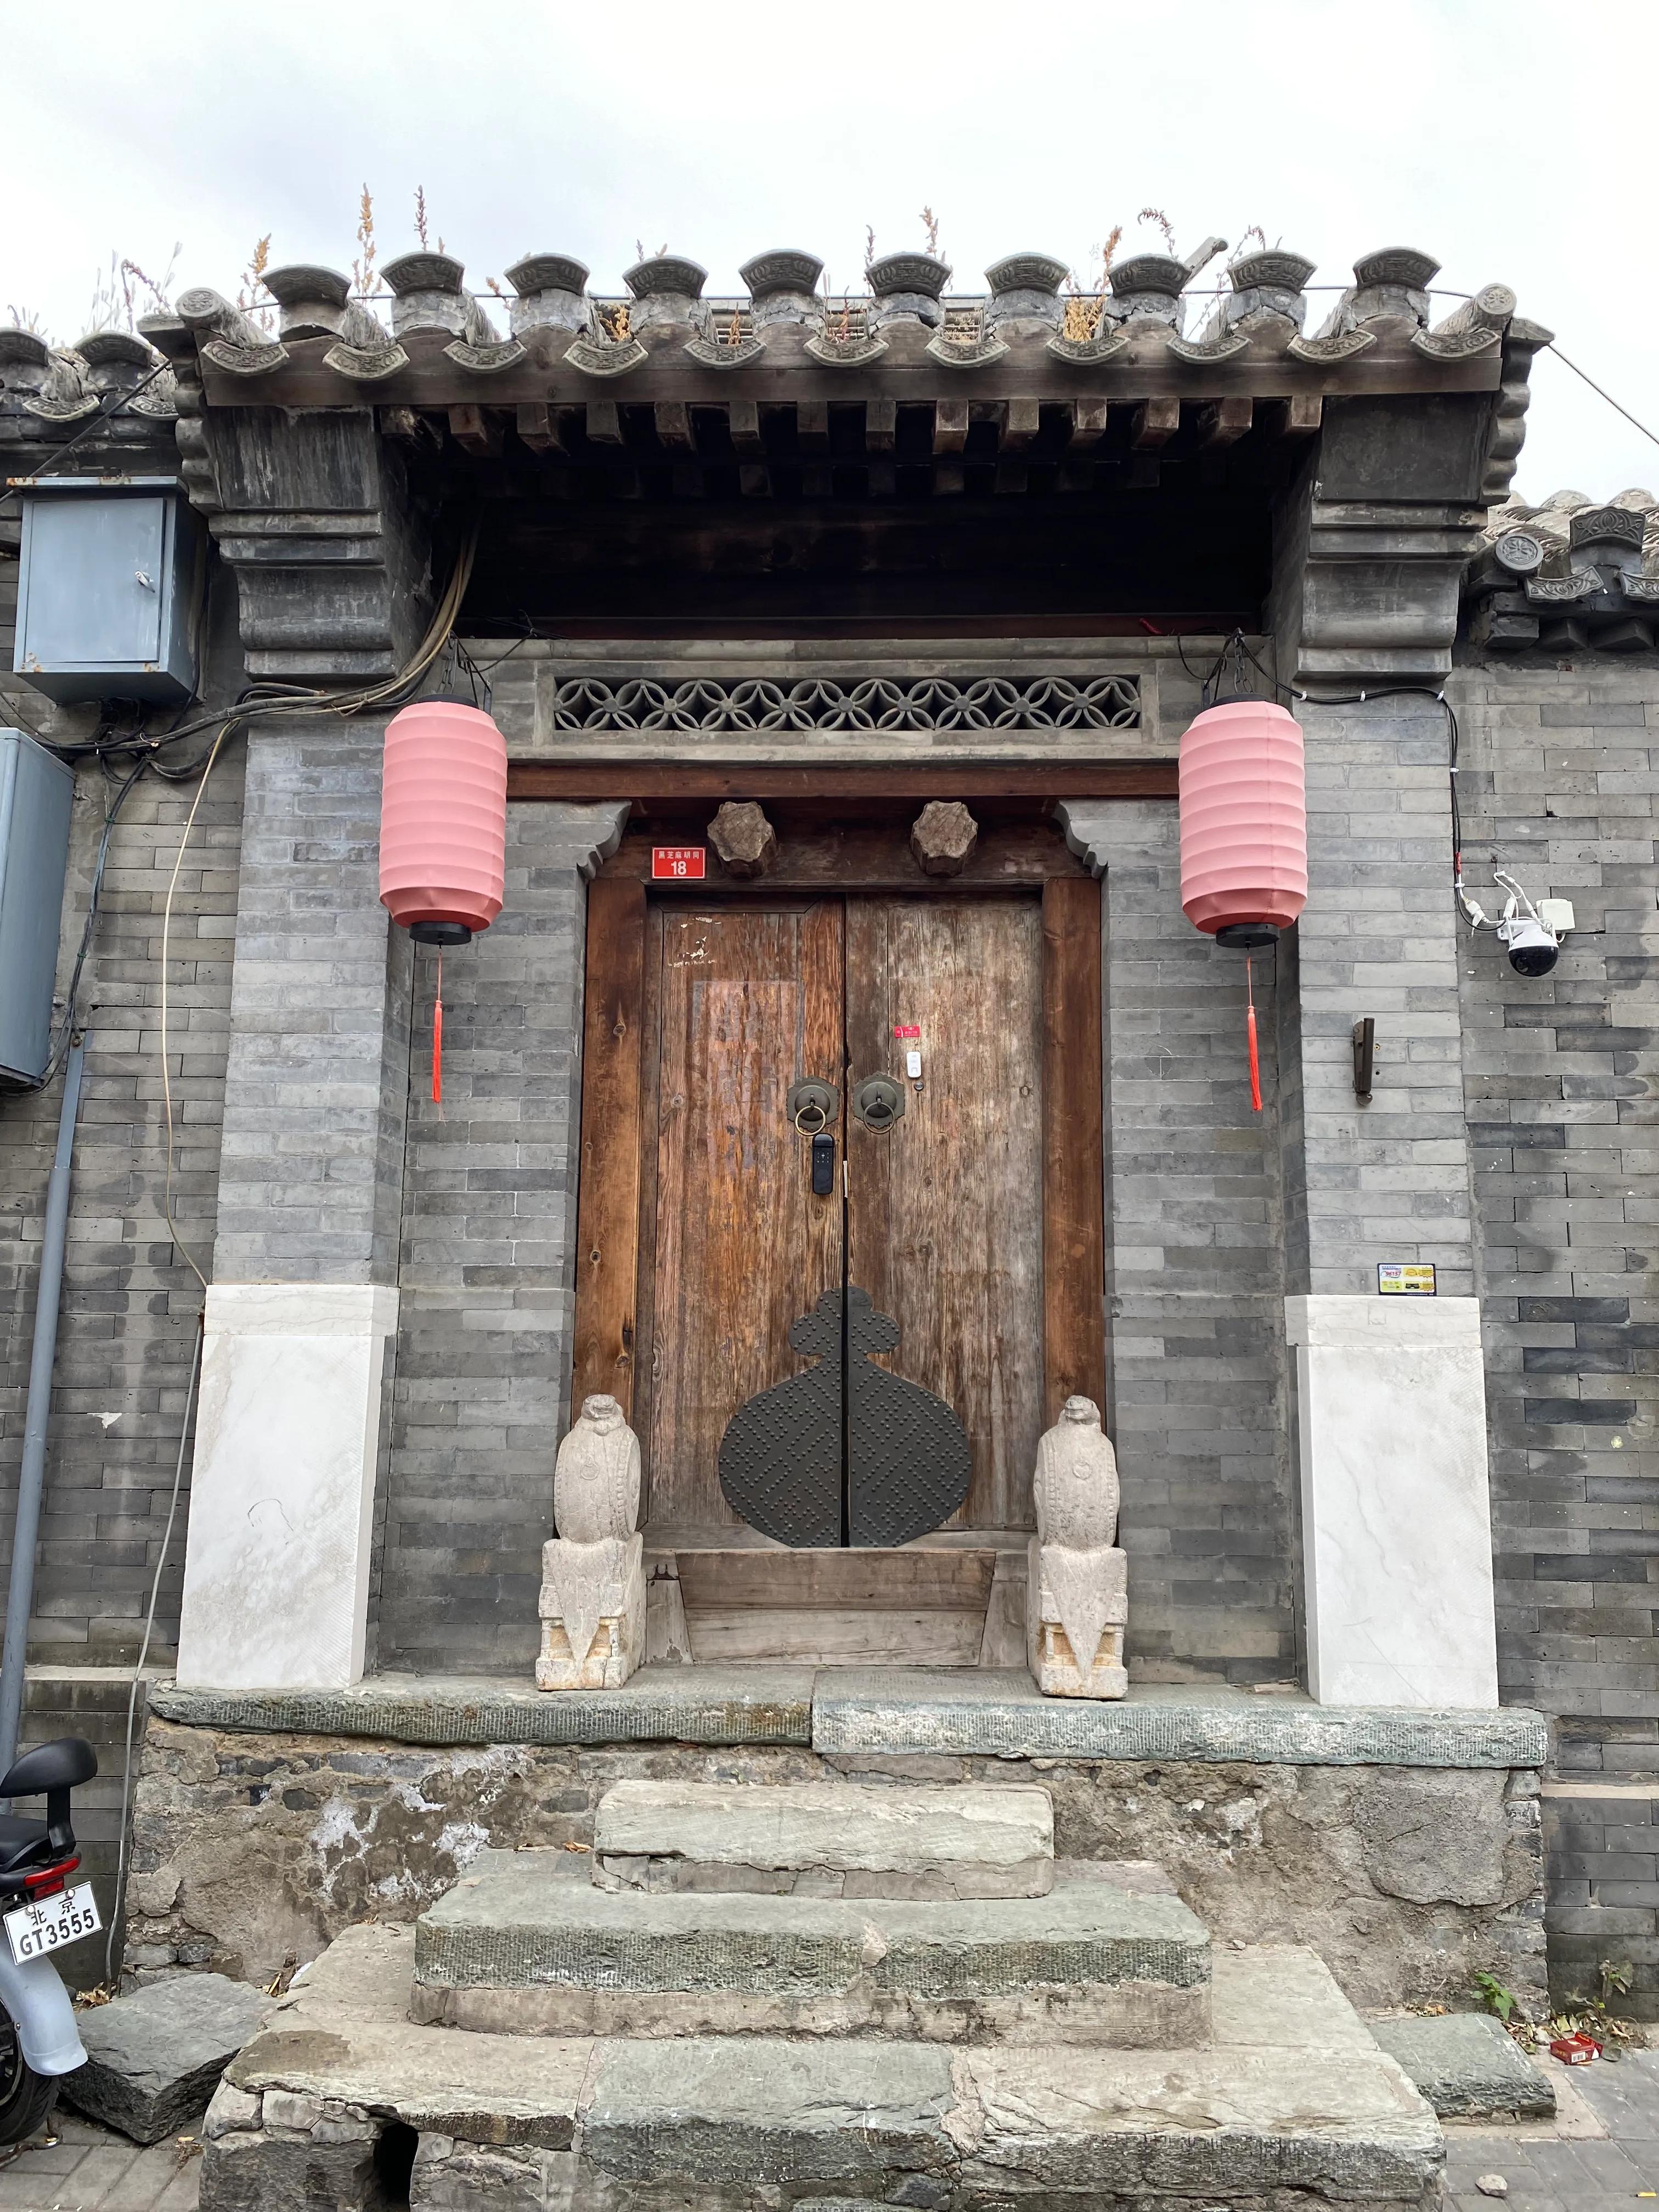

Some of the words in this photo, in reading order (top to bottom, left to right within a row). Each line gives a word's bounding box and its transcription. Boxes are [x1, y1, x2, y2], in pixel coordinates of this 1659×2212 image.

[670, 861, 687, 876] 18
[31, 1898, 76, 1926] 北京
[20, 1908, 94, 1955] GT3555
